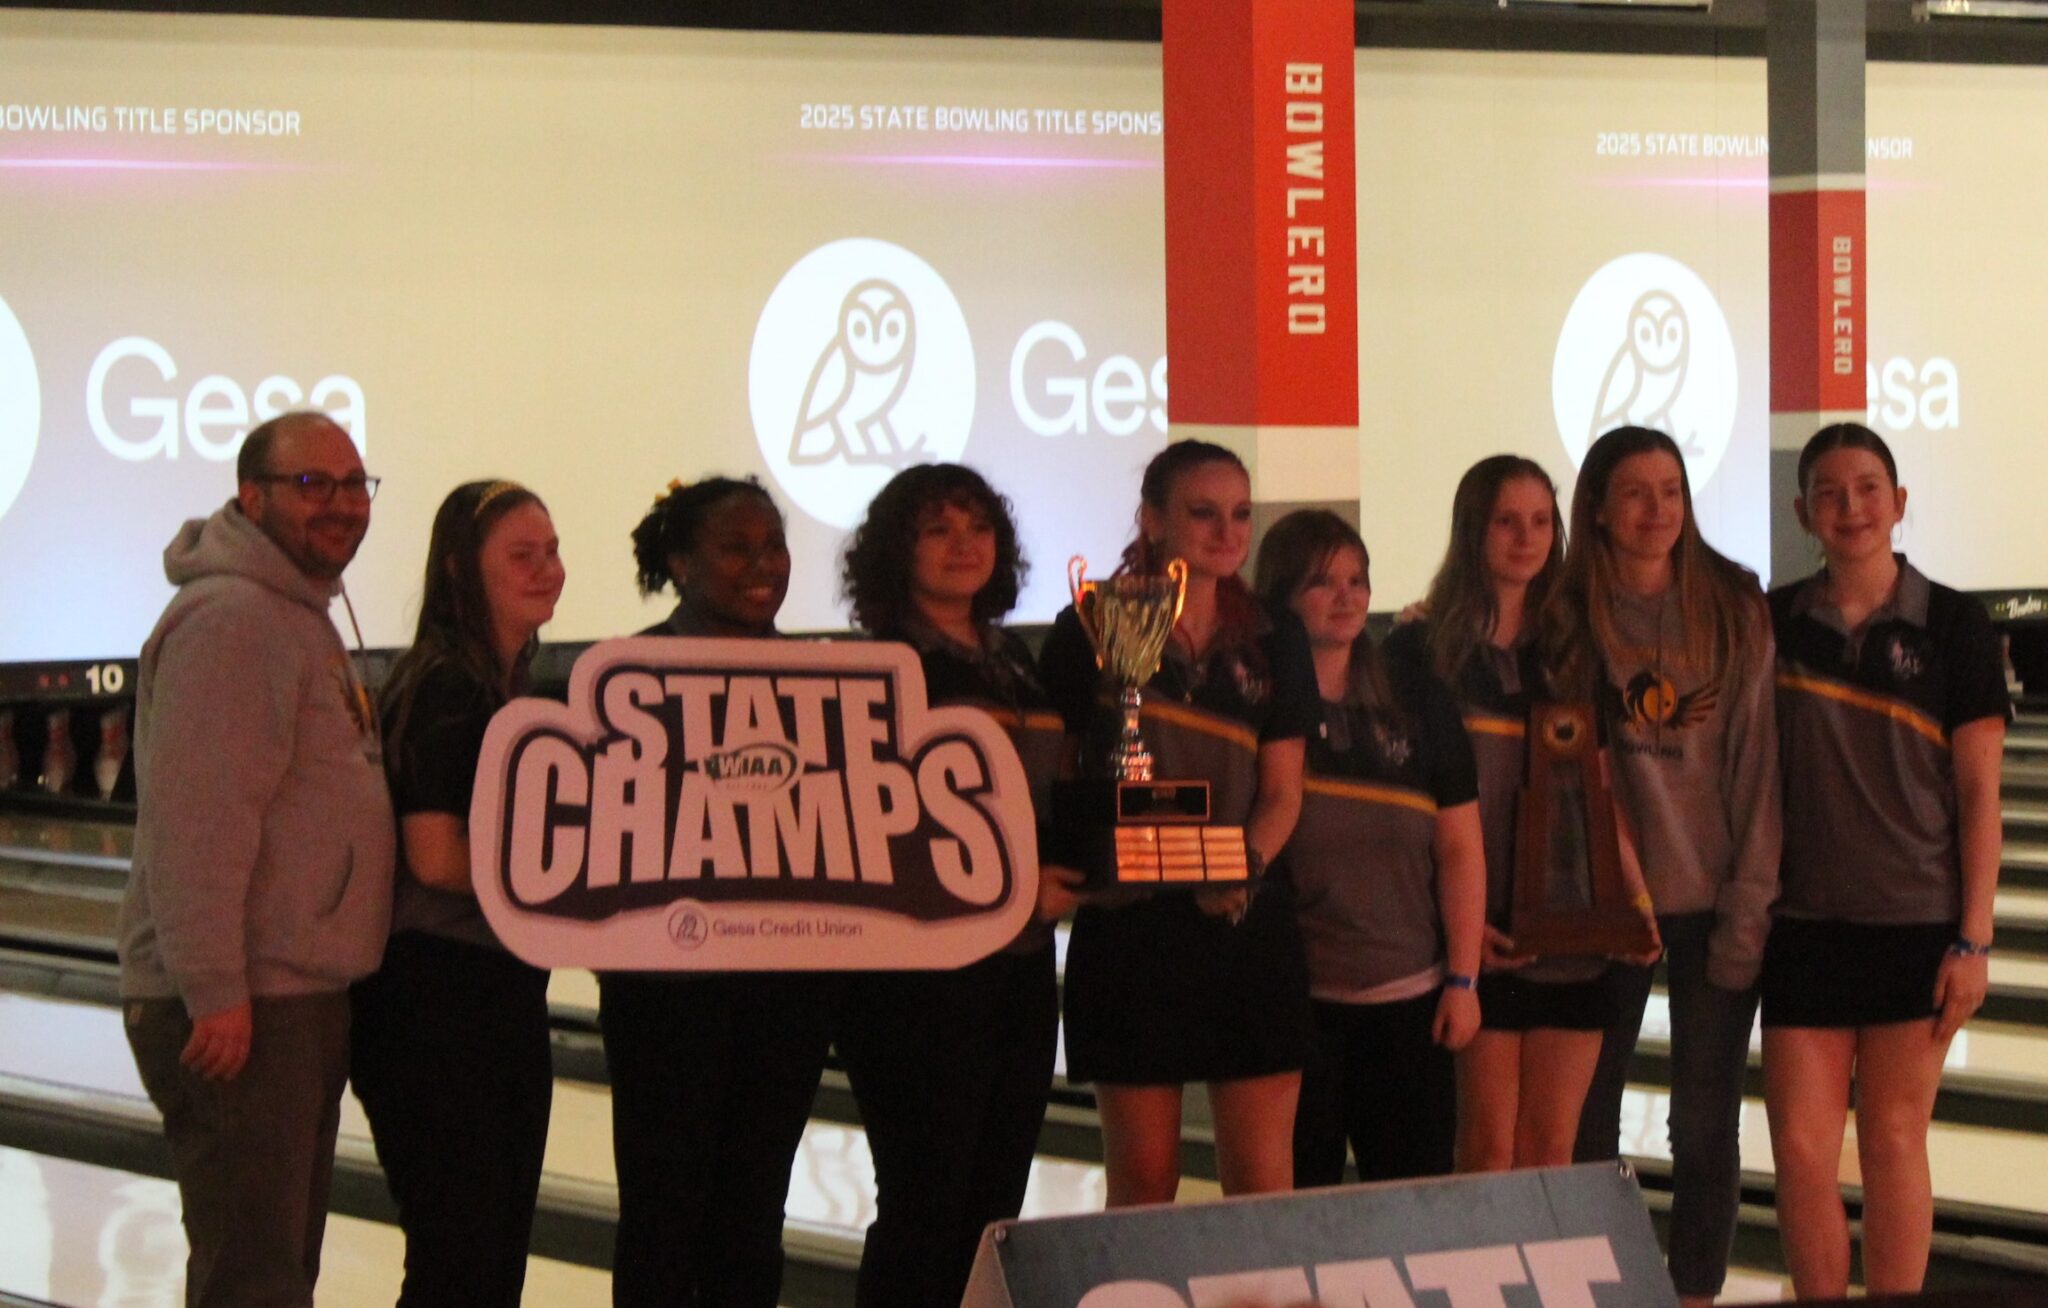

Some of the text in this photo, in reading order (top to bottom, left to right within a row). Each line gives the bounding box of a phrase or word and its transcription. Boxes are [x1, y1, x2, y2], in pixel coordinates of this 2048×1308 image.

[113, 106, 177, 134] TITLE
[184, 108, 301, 136] SPONSOR
[800, 103, 1163, 135] 2025 STATE BOWLING TITLE SPONS
[1596, 132, 1913, 160] 2025 STATE BOWLIN NSOR
[1285, 62, 1326, 335] BOWLERO
[1833, 236, 1852, 375] BOWLERO
[1009, 320, 1167, 436] Ge
[86, 663, 124, 694] 10
[603, 671, 890, 768] STATE
[716, 755, 784, 778] WIAA
[509, 734, 1004, 906] CHAMPS
[713, 917, 863, 937] Gesa Credit Union
